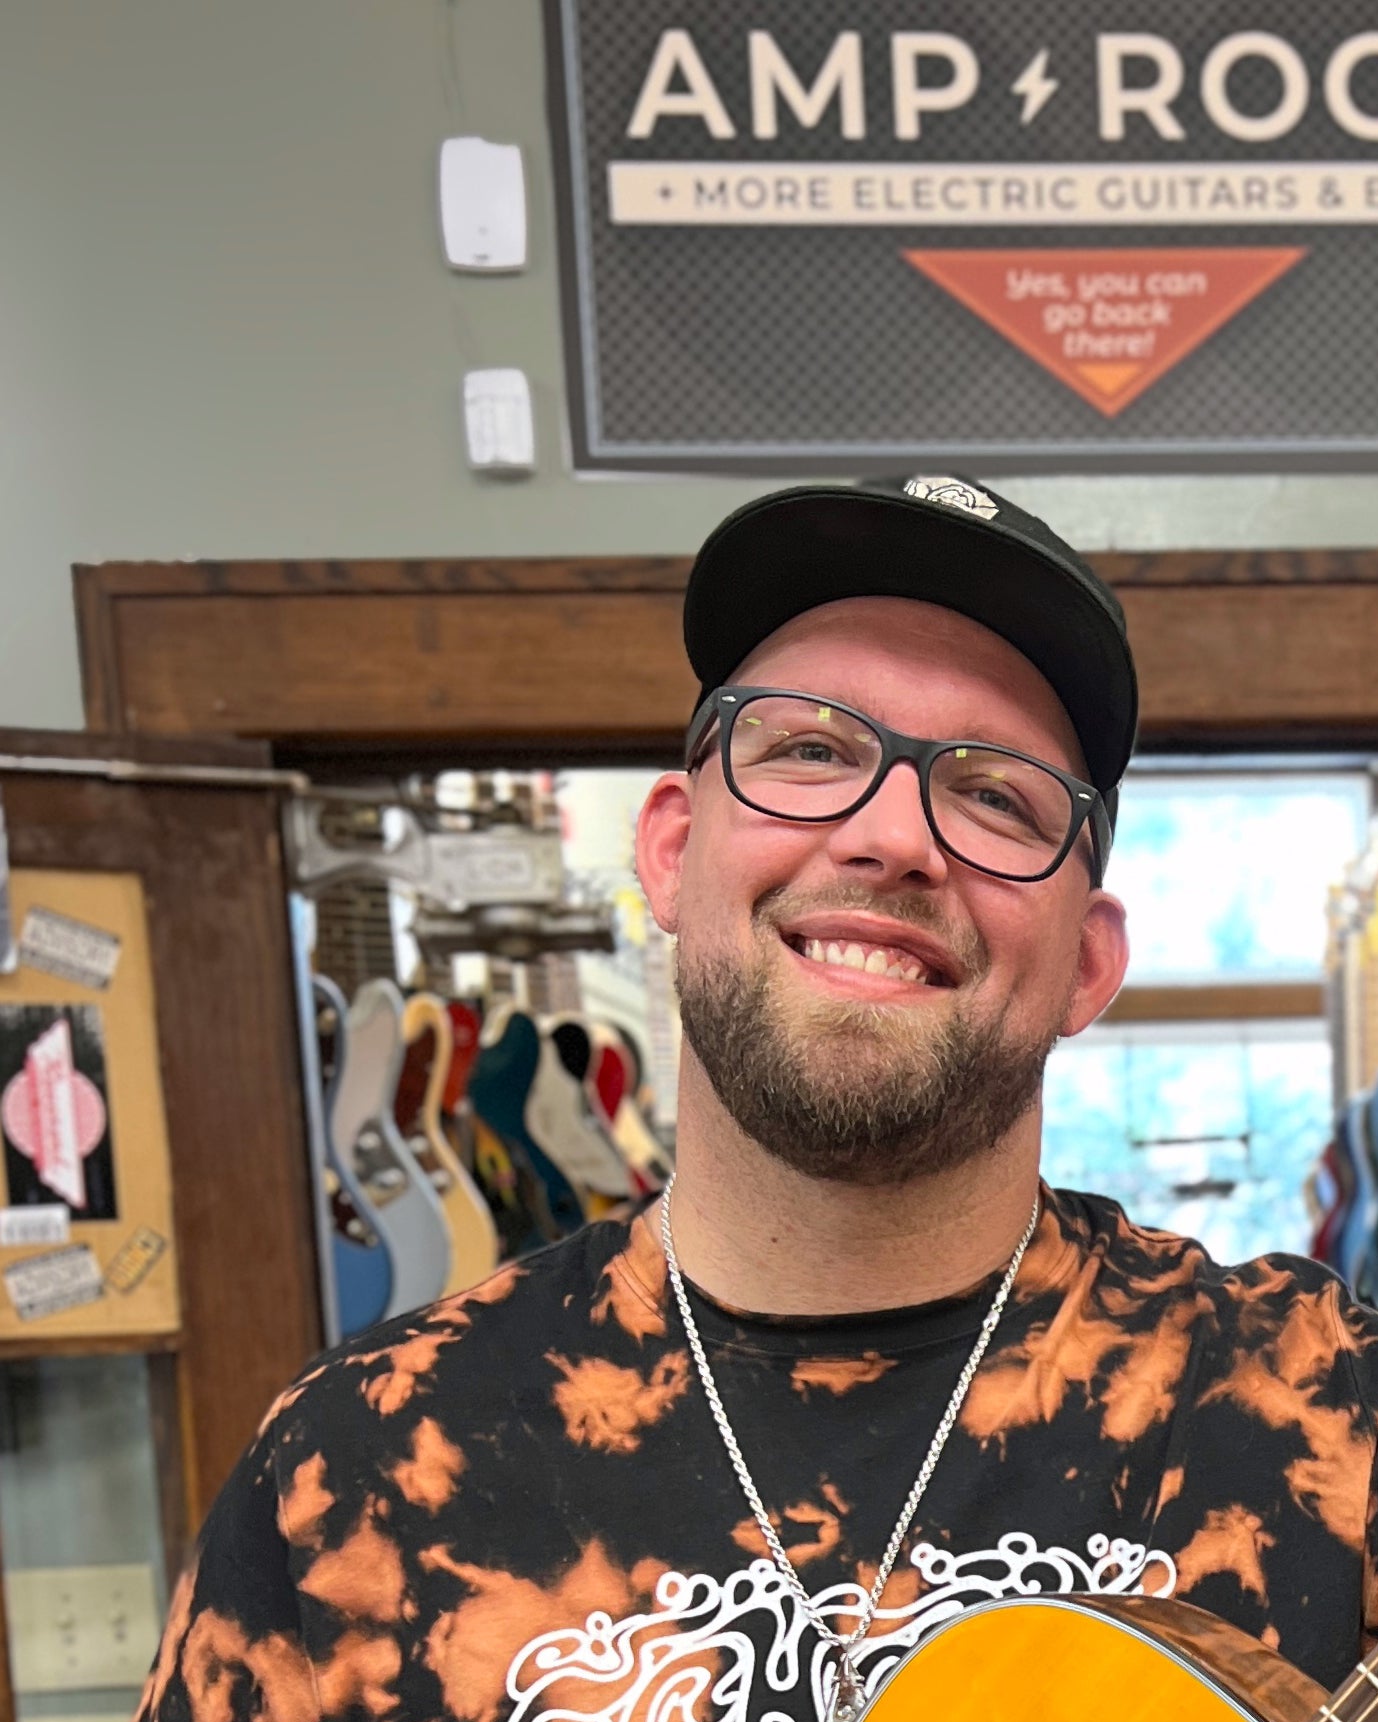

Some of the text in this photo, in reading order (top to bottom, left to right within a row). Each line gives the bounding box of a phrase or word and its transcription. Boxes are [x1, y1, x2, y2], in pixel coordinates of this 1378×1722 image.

[626, 28, 981, 140] AMP
[694, 176, 831, 210] MORE
[853, 176, 1079, 210] ELECTRIC
[1096, 176, 1299, 210] GUITARS
[1317, 178, 1344, 208] &
[1006, 268, 1208, 301] Yes, you can
[1042, 299, 1172, 333] go back
[1062, 330, 1156, 358] there!
